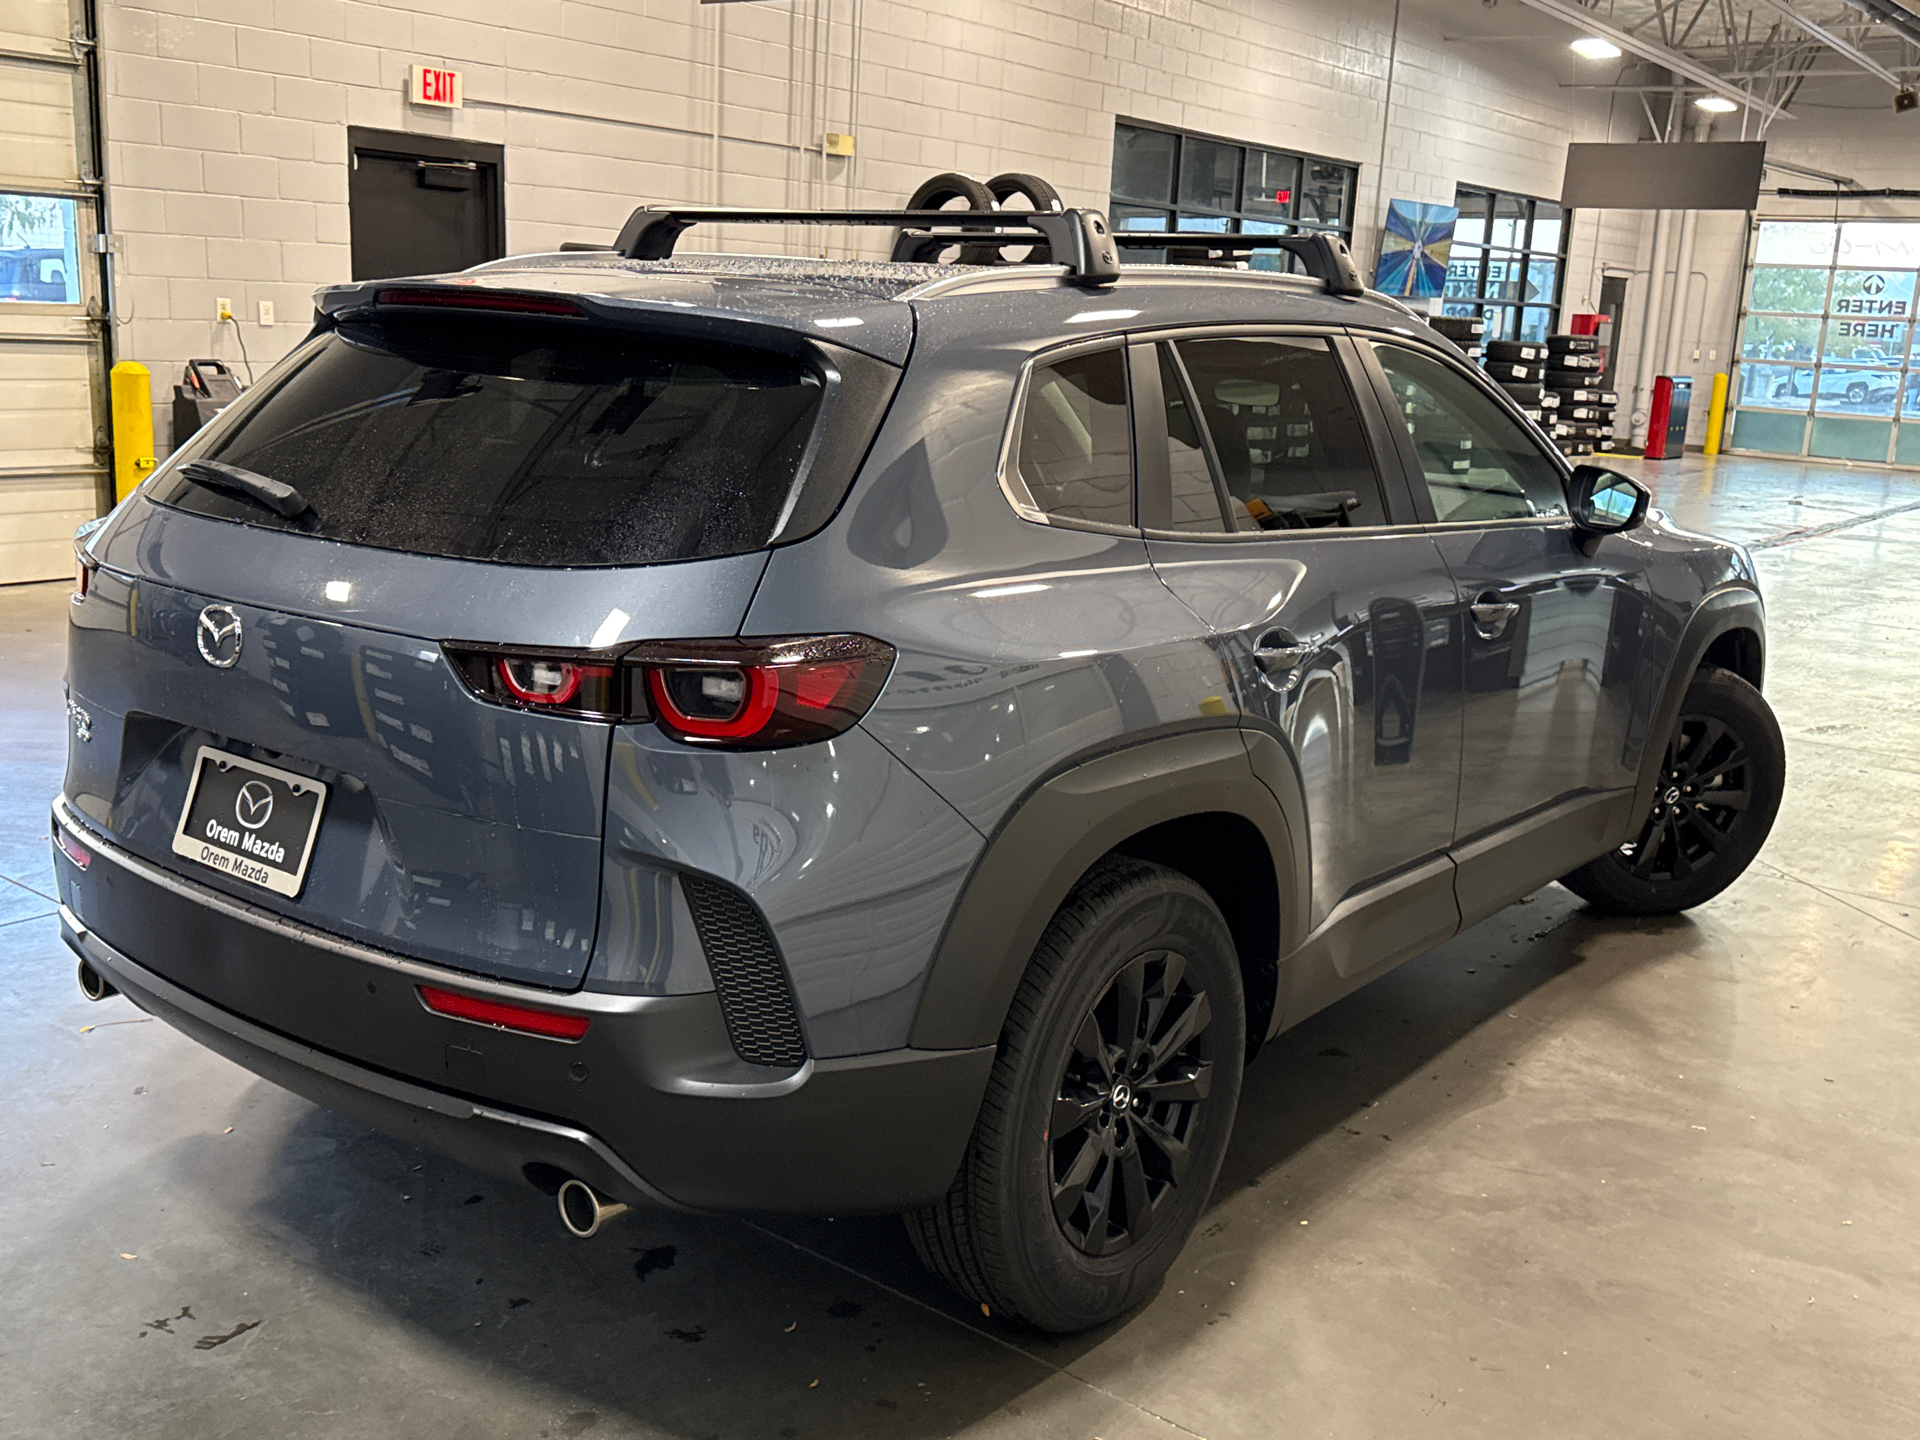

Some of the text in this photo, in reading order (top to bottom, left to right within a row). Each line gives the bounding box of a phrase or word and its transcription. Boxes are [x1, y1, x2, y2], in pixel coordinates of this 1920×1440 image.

[423, 68, 456, 104] EXIT
[205, 819, 285, 863] Orem Mazda
[200, 846, 269, 884] Orem Mazda
